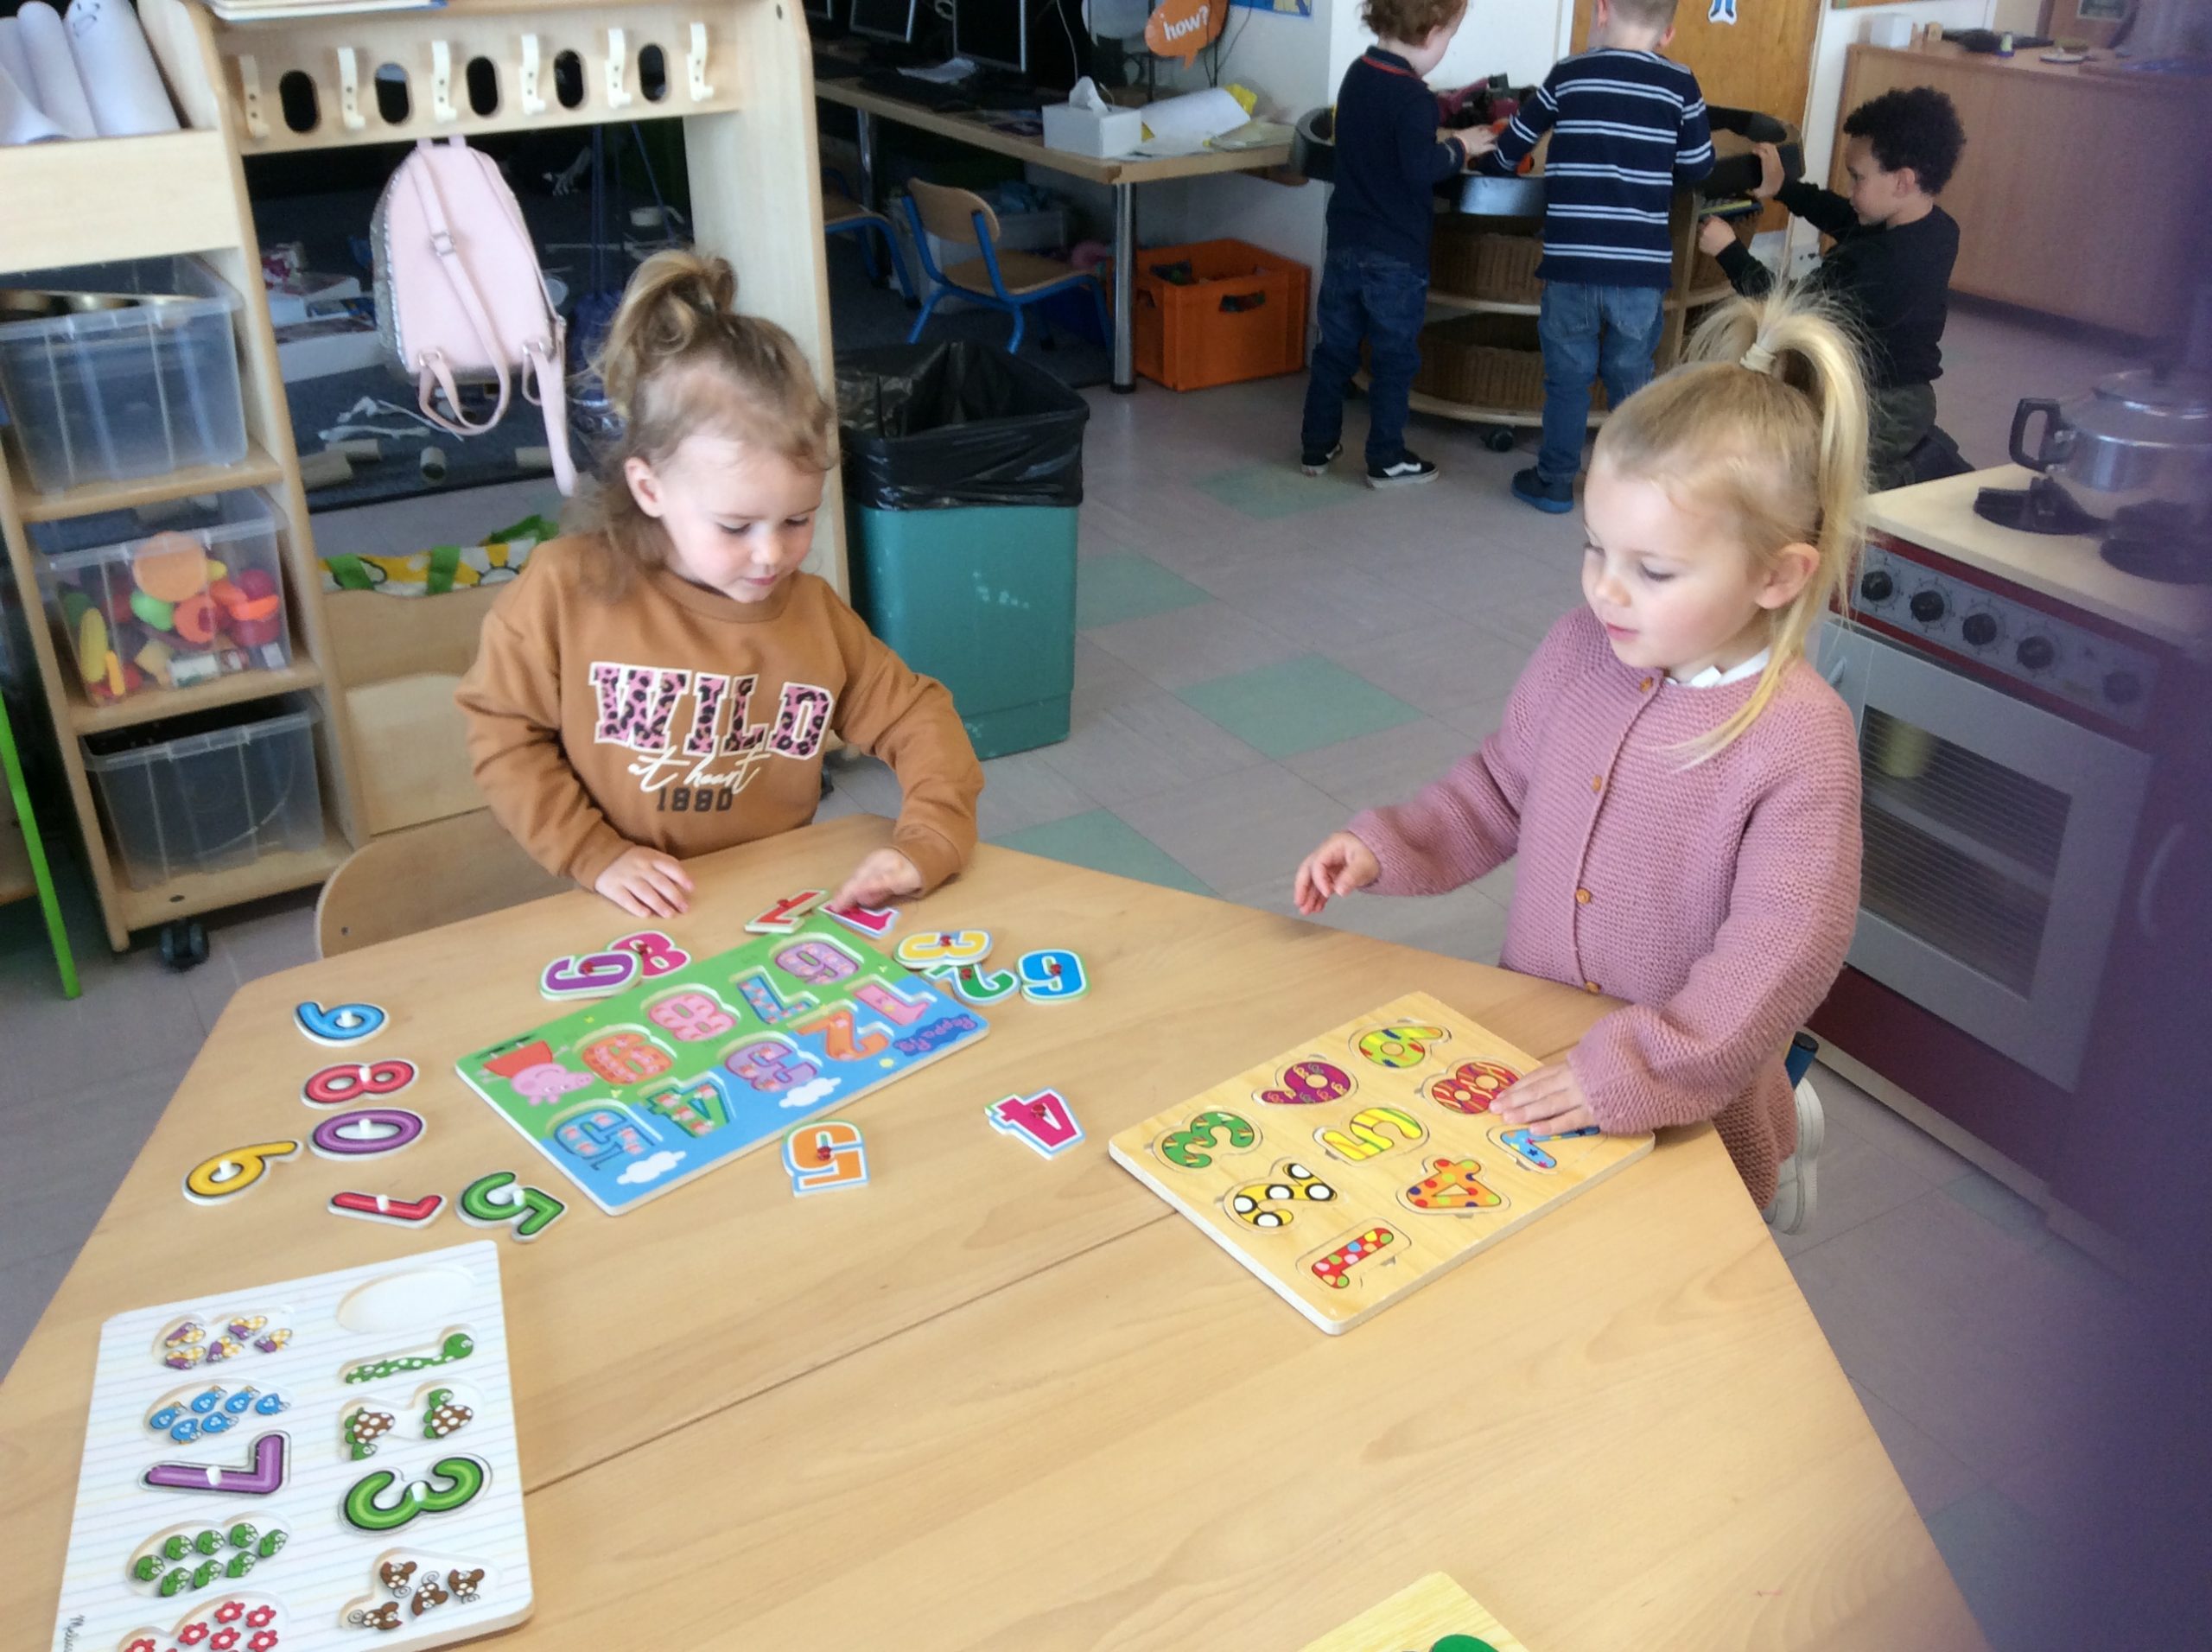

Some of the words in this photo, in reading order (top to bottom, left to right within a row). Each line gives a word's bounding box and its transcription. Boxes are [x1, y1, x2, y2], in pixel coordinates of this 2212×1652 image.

[1161, 4, 1210, 41] how?
[588, 662, 835, 760] WILD
[627, 745, 690, 792] at
[683, 742, 772, 795] heart
[657, 786, 734, 813] 1880
[304, 1059, 416, 1104] 8
[985, 1087, 1085, 1160] 4
[1161, 1111, 1256, 1169] 3
[1405, 1158, 1503, 1209] 4
[344, 1456, 486, 1531] 3
